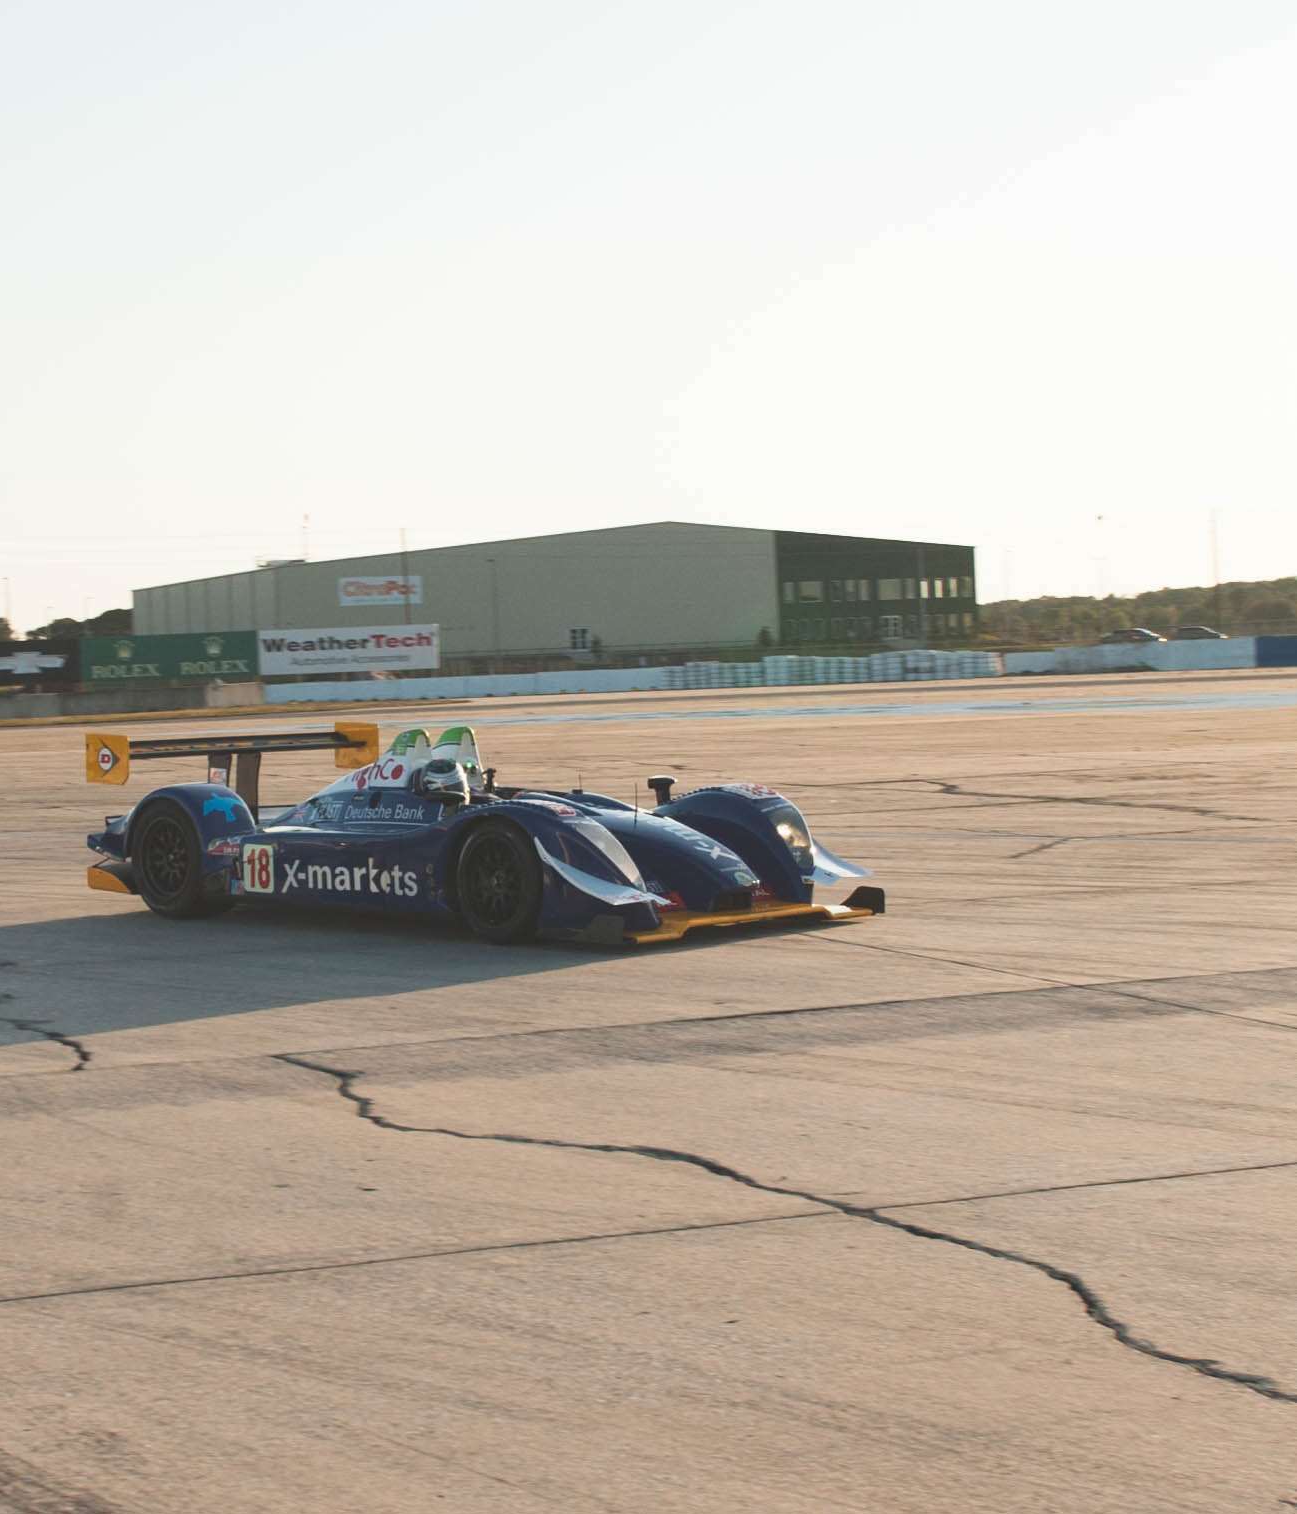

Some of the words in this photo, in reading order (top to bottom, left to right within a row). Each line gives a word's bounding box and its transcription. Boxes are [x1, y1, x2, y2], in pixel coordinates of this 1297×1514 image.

[261, 632, 433, 652] WeatherTech
[91, 663, 160, 679] ROLEX
[180, 660, 249, 676] ROLEX
[344, 804, 392, 820] Deutsche
[394, 803, 425, 820] Bank
[246, 847, 271, 889] 18
